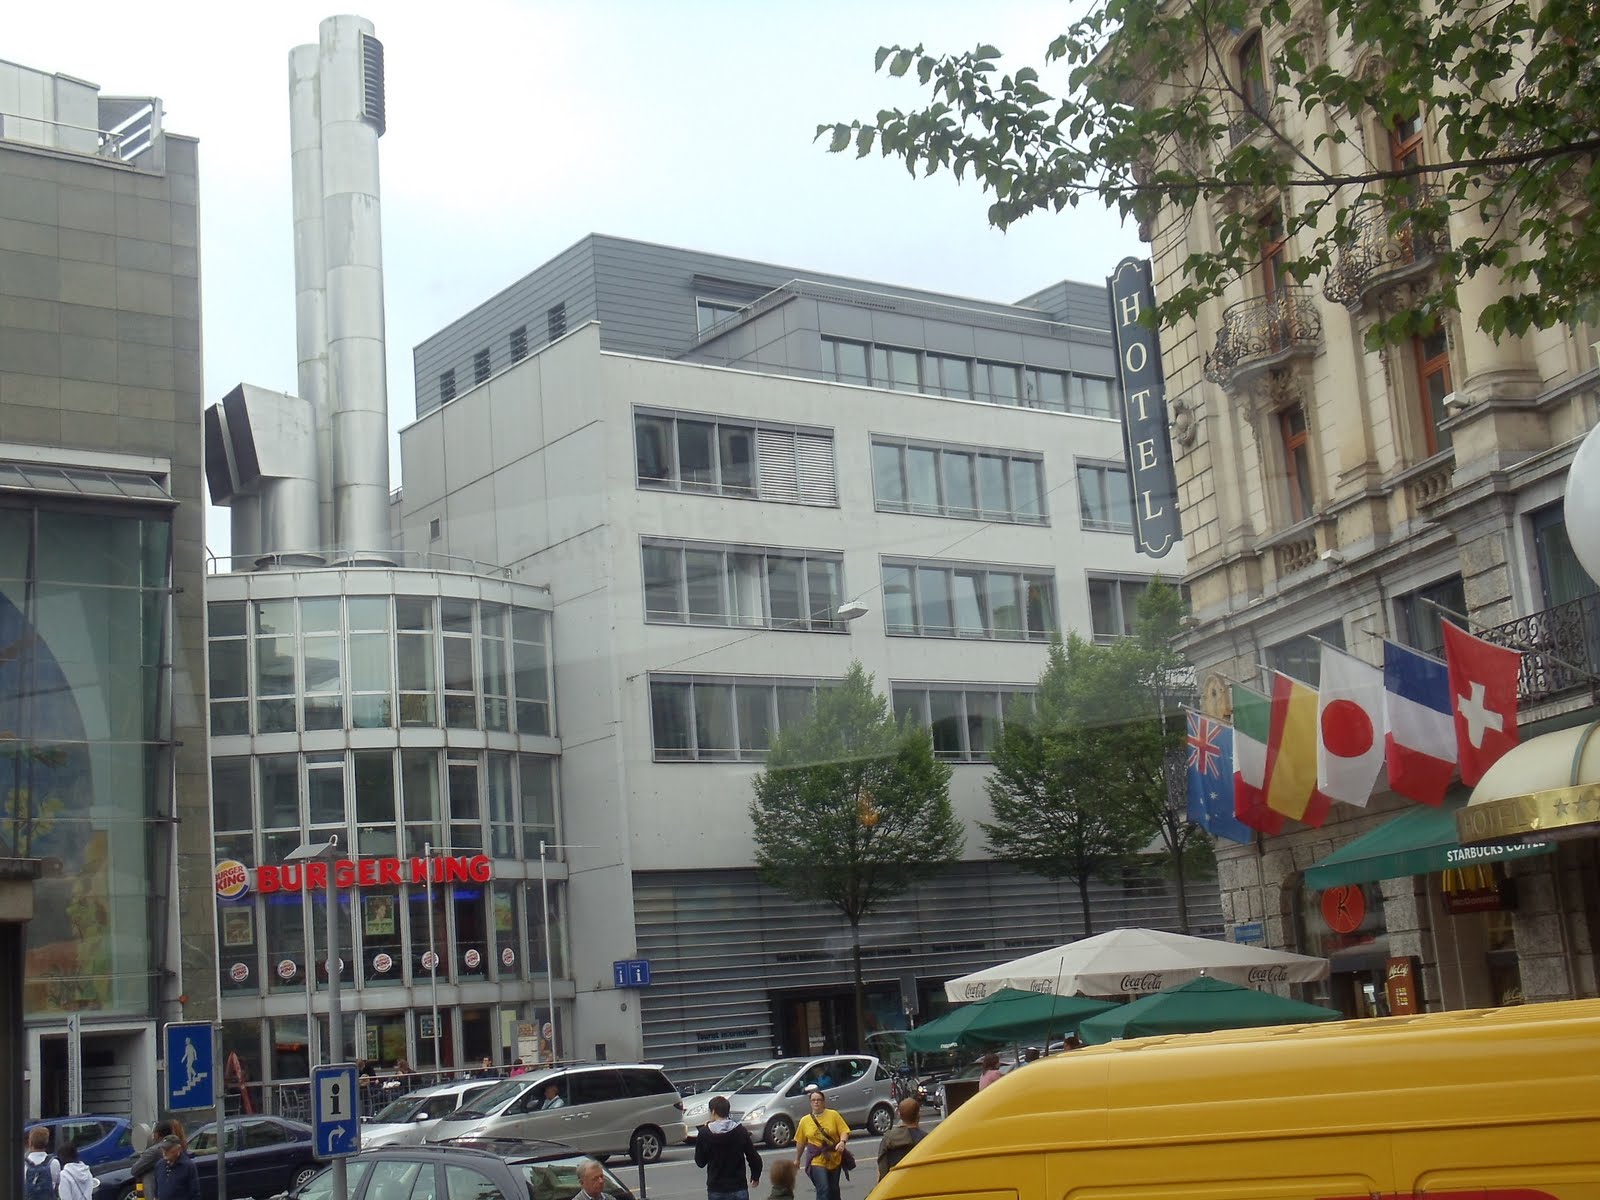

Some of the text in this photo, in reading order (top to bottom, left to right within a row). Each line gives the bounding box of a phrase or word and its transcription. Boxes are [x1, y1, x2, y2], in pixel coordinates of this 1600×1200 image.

[1119, 291, 1163, 520] HOTEL
[1462, 802, 1529, 834] HOTEL
[1447, 845, 1503, 862] STARBUCKS
[215, 872, 246, 892] KING
[257, 855, 490, 893] BURGER KING
[1120, 973, 1163, 991] Coca-Cola
[1248, 965, 1288, 983] Coca-Cola
